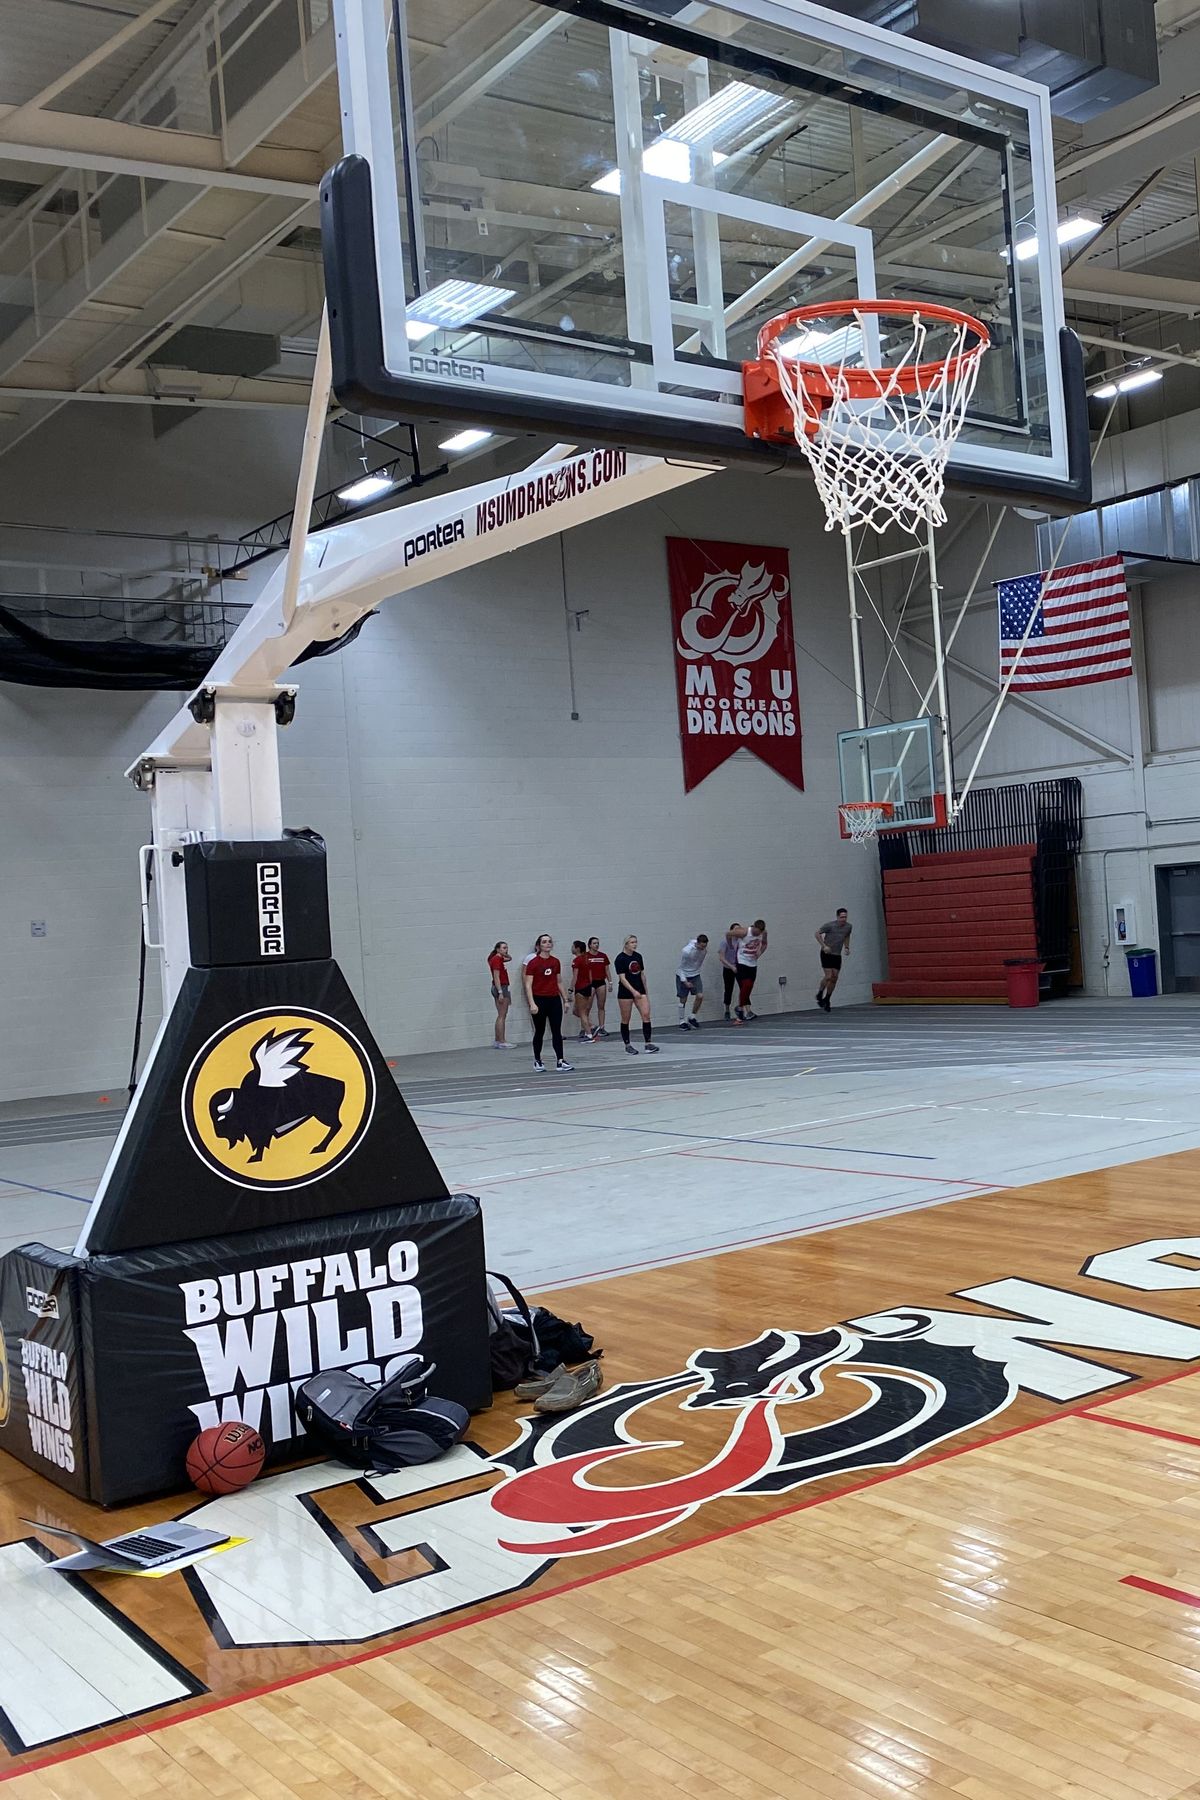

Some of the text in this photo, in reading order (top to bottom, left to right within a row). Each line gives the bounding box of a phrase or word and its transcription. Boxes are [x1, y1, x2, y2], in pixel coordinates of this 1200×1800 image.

[687, 697, 792, 712] MOORHEAD
[687, 709, 796, 736] DRAGONS
[178, 1240, 419, 1325] BUFFALO
[18, 1338, 68, 1381] BUFFALO
[182, 1284, 424, 1397] WILD
[22, 1366, 71, 1432] WILD
[28, 1414, 75, 1474] WINGS
